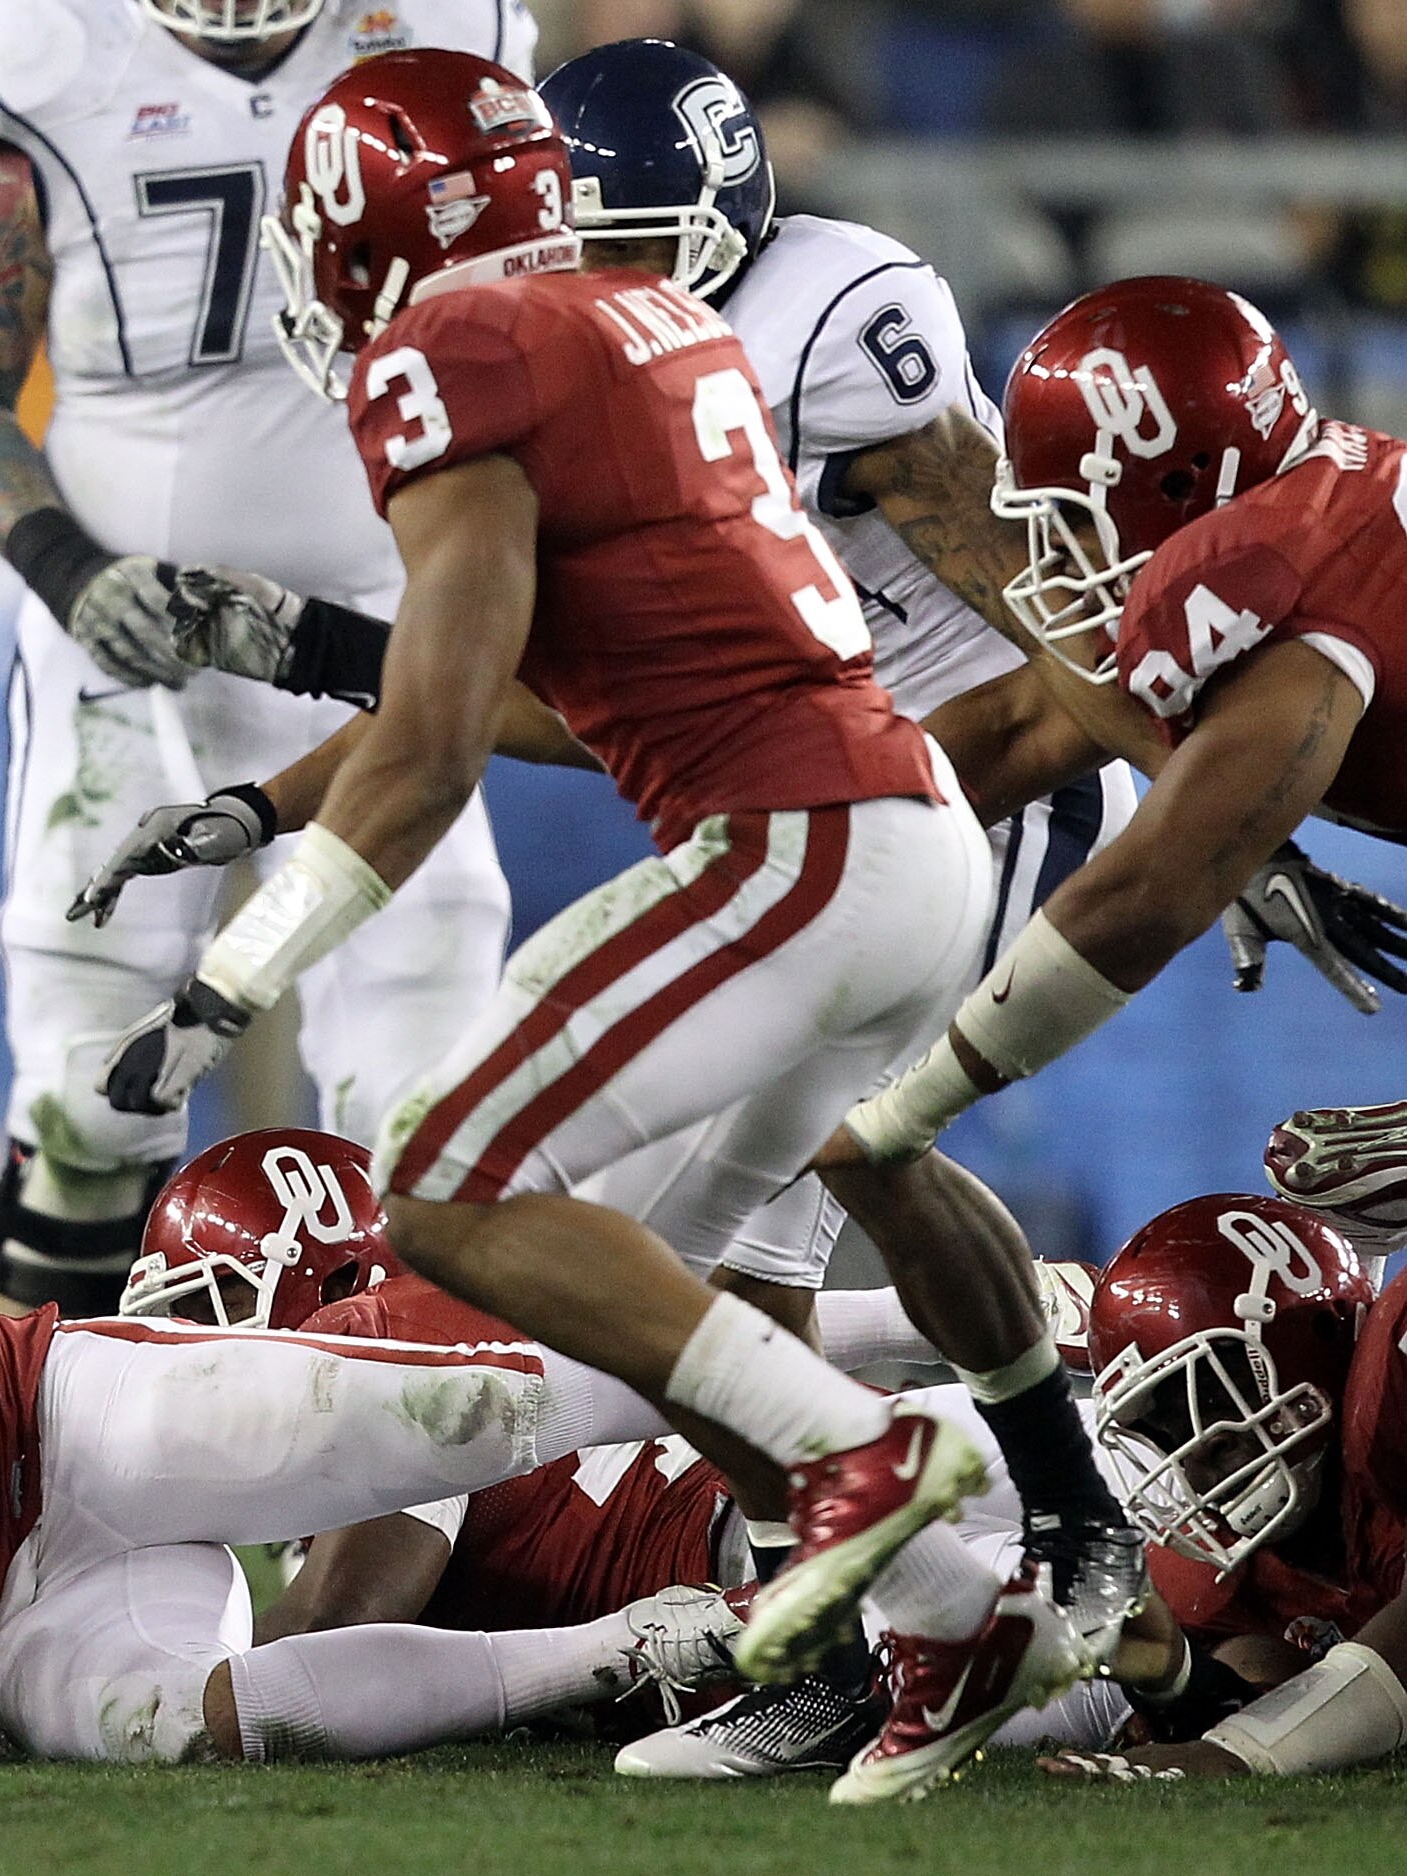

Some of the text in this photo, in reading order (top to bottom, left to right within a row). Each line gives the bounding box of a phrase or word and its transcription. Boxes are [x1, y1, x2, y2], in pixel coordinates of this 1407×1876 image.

[305, 104, 365, 226] OU
[534, 169, 563, 231] 3
[365, 346, 454, 472] 3
[857, 302, 945, 408] 6
[1077, 347, 1178, 459] OU
[691, 368, 872, 662] 3
[261, 1146, 355, 1244] OU
[1217, 1210, 1323, 1294] OU
